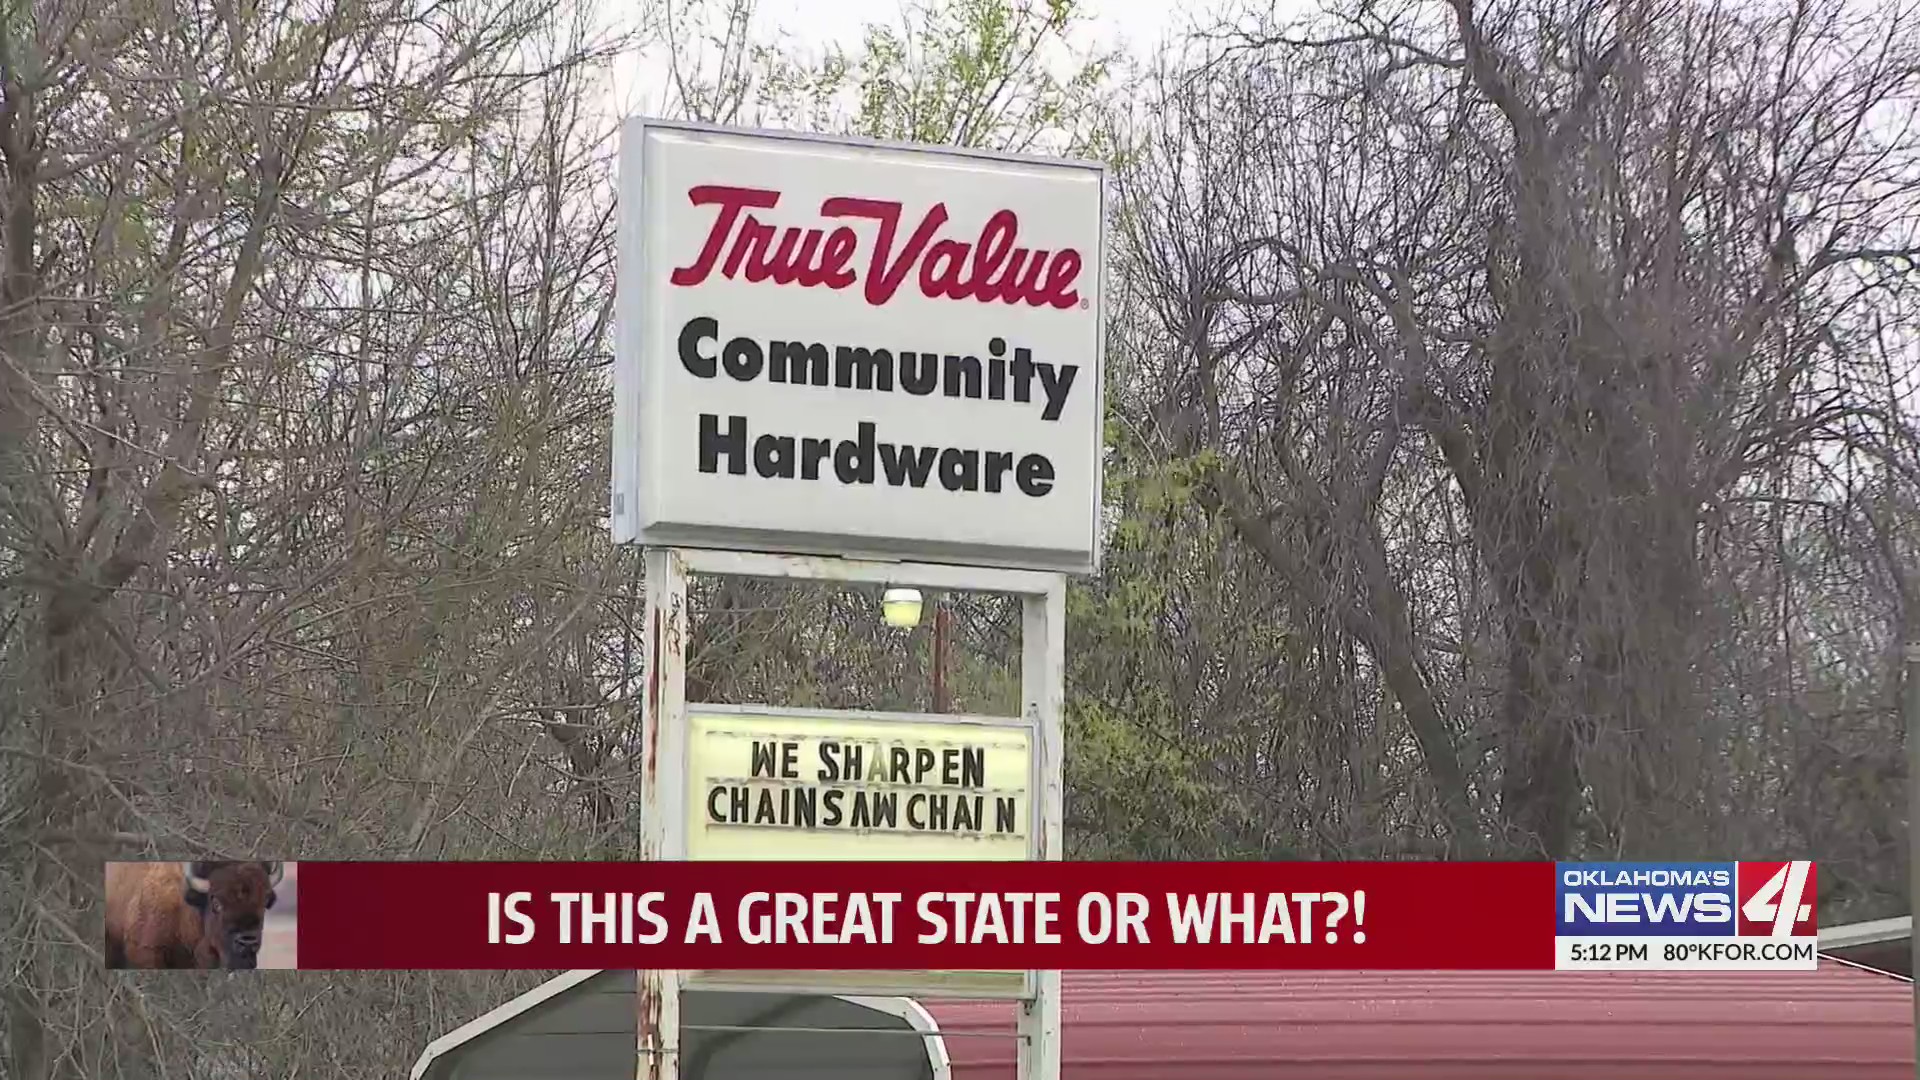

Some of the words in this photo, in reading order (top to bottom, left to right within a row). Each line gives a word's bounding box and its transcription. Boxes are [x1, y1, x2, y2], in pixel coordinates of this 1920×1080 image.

[677, 316, 1079, 421] Community
[698, 413, 1056, 498] Hardware
[751, 741, 799, 778] WE
[817, 741, 985, 788] SHARPEN
